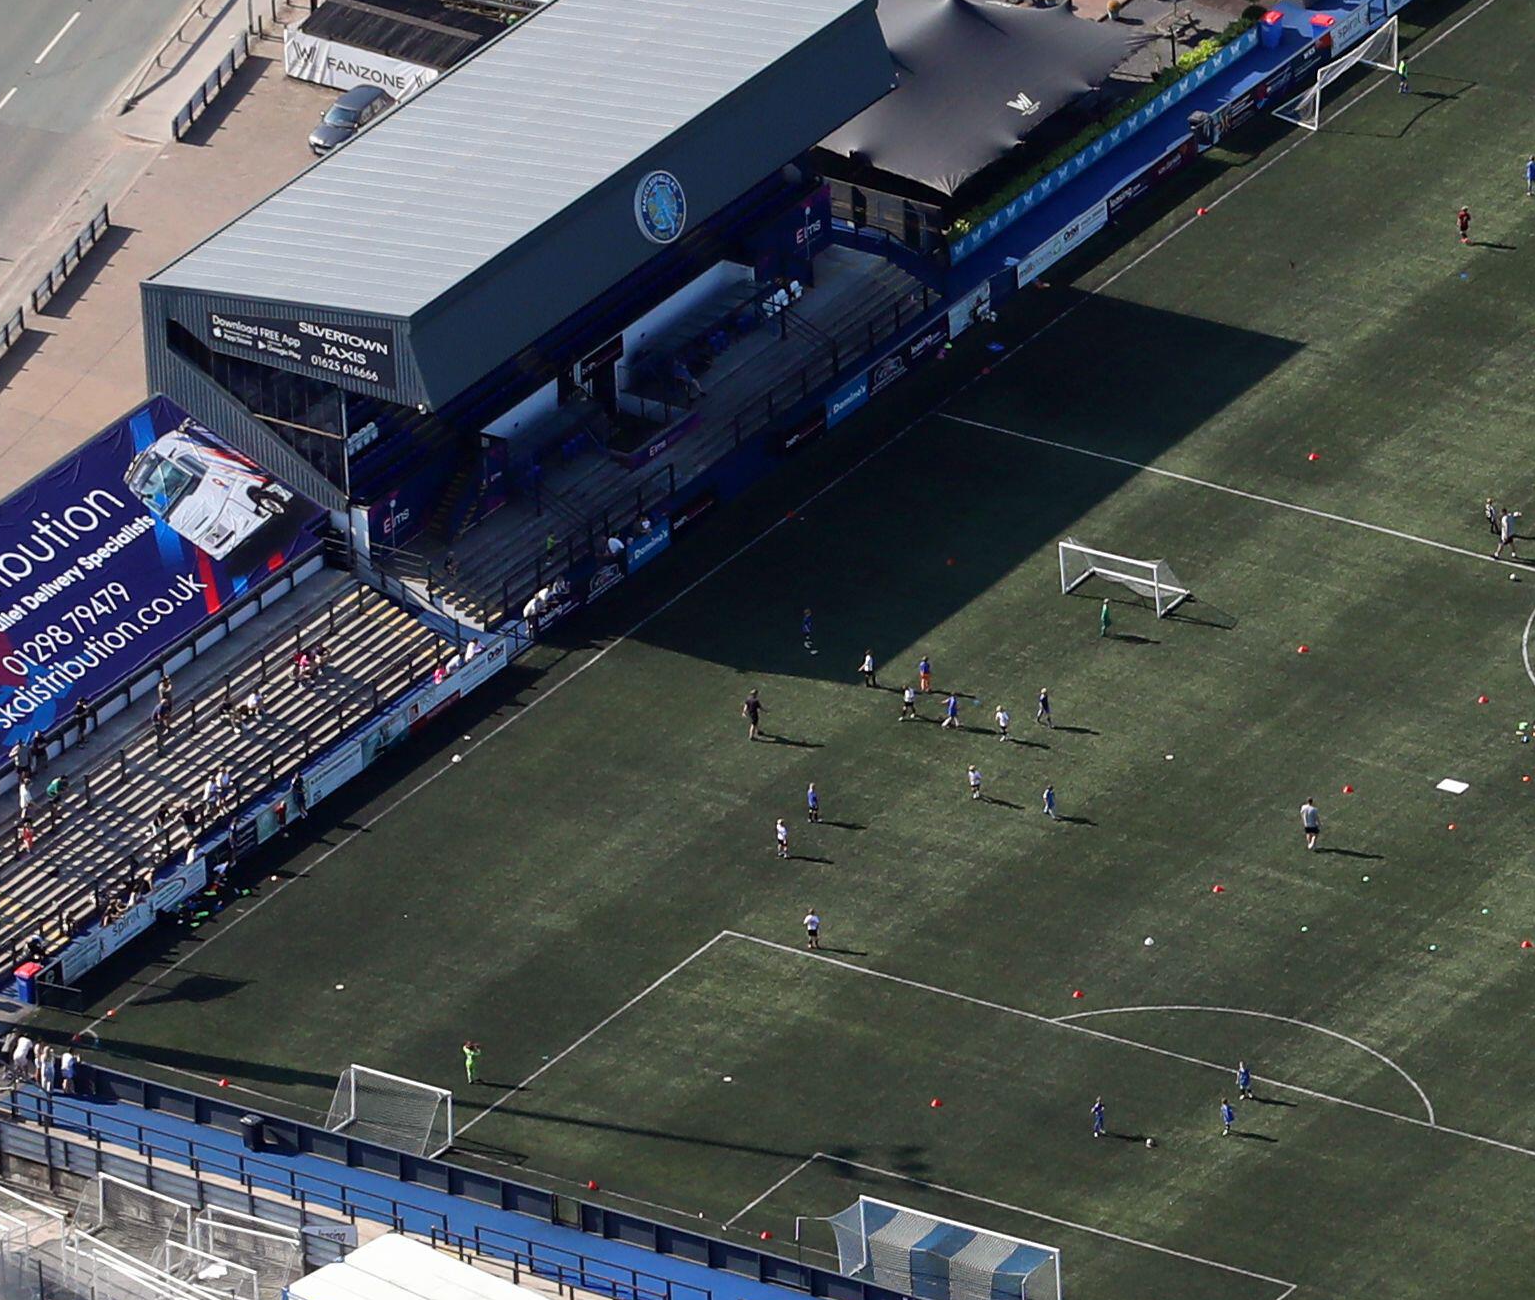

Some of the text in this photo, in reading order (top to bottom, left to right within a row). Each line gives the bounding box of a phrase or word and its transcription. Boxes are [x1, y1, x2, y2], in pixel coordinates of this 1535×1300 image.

[327, 57, 406, 89] FANZONE
[212, 314, 258, 335] Download
[259, 326, 280, 341] FREE
[281, 333, 301, 348] App
[298, 321, 388, 355] SILVERTOWN
[311, 354, 379, 382] 01625 616666
[321, 343, 367, 365] TAXIS
[383, 506, 410, 534] Ems
[19, 563, 87, 614] Delivery
[79, 513, 156, 572] Specialists
[1, 581, 131, 680] 01298 79479
